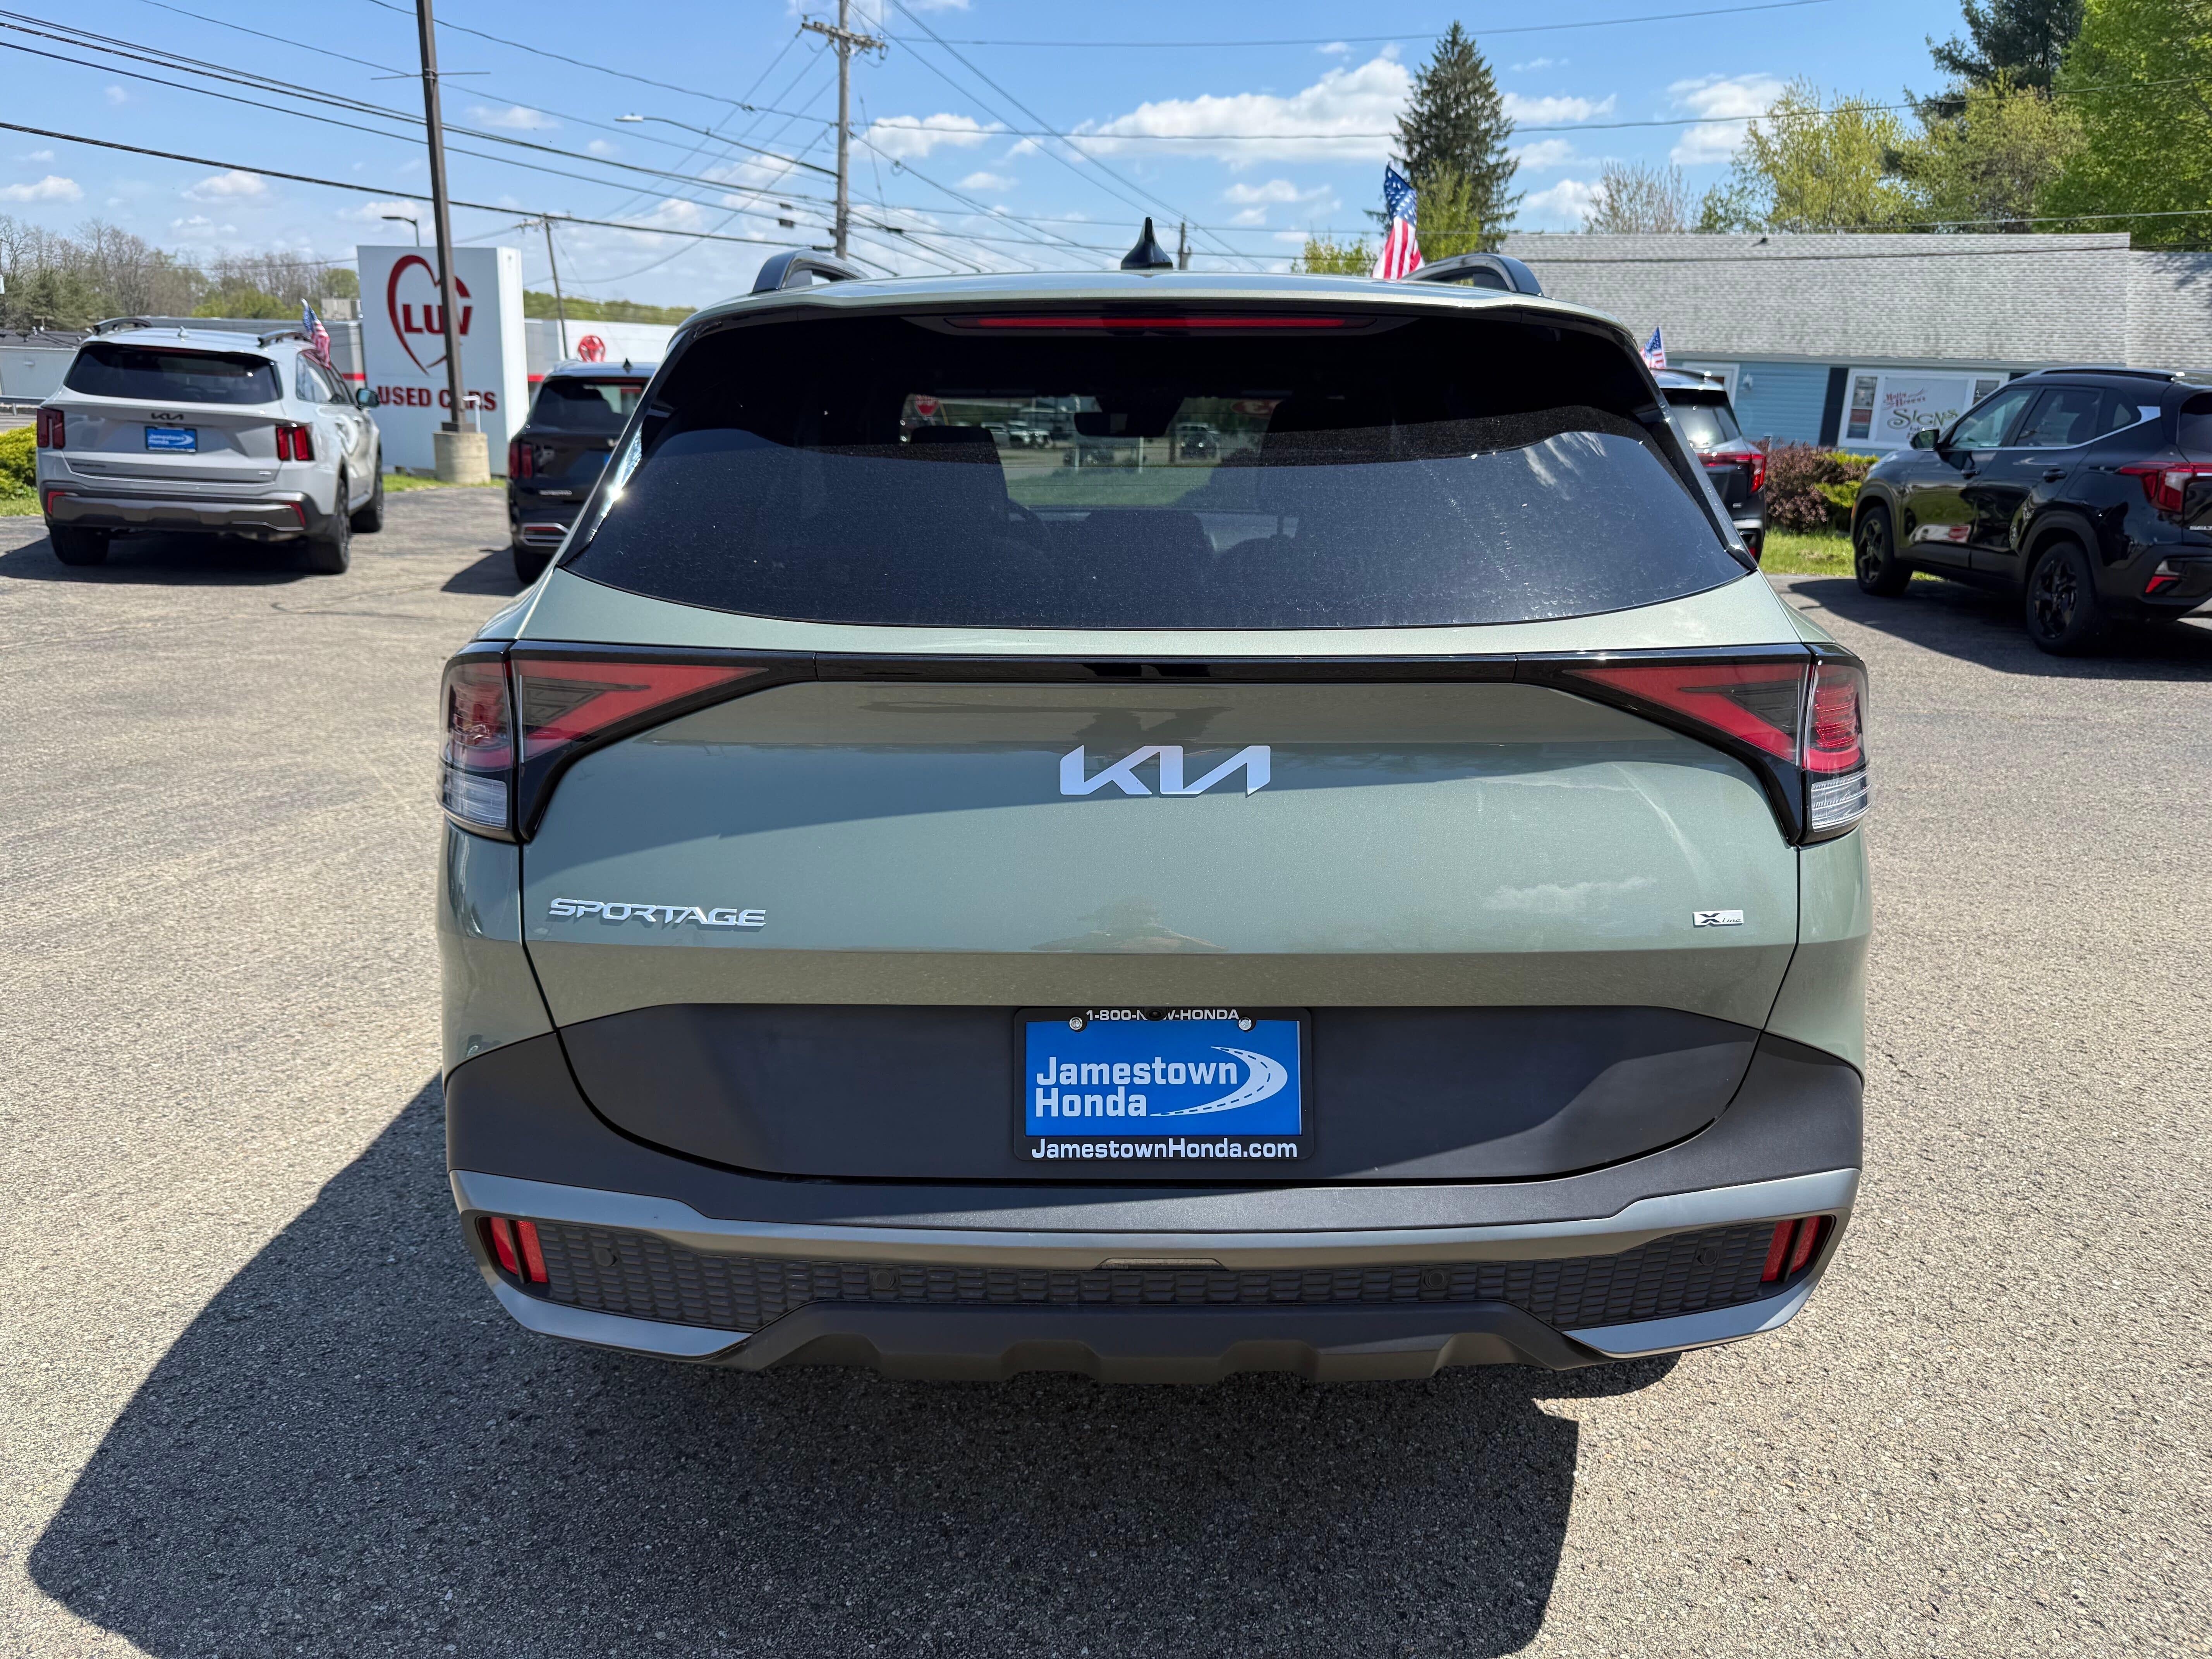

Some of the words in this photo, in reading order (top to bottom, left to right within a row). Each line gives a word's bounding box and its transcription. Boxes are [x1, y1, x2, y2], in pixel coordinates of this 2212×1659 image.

[378, 386, 432, 407] USED
[1060, 745, 1271, 795] KIA
[548, 898, 766, 927] SPORTAGE
[1086, 1010, 1239, 1020] 1-800-NW-HONDA
[1036, 1056, 1237, 1085] Jamestown
[1036, 1086, 1146, 1117] Honda
[1032, 1138, 1297, 1158] JamestownHonda.com
